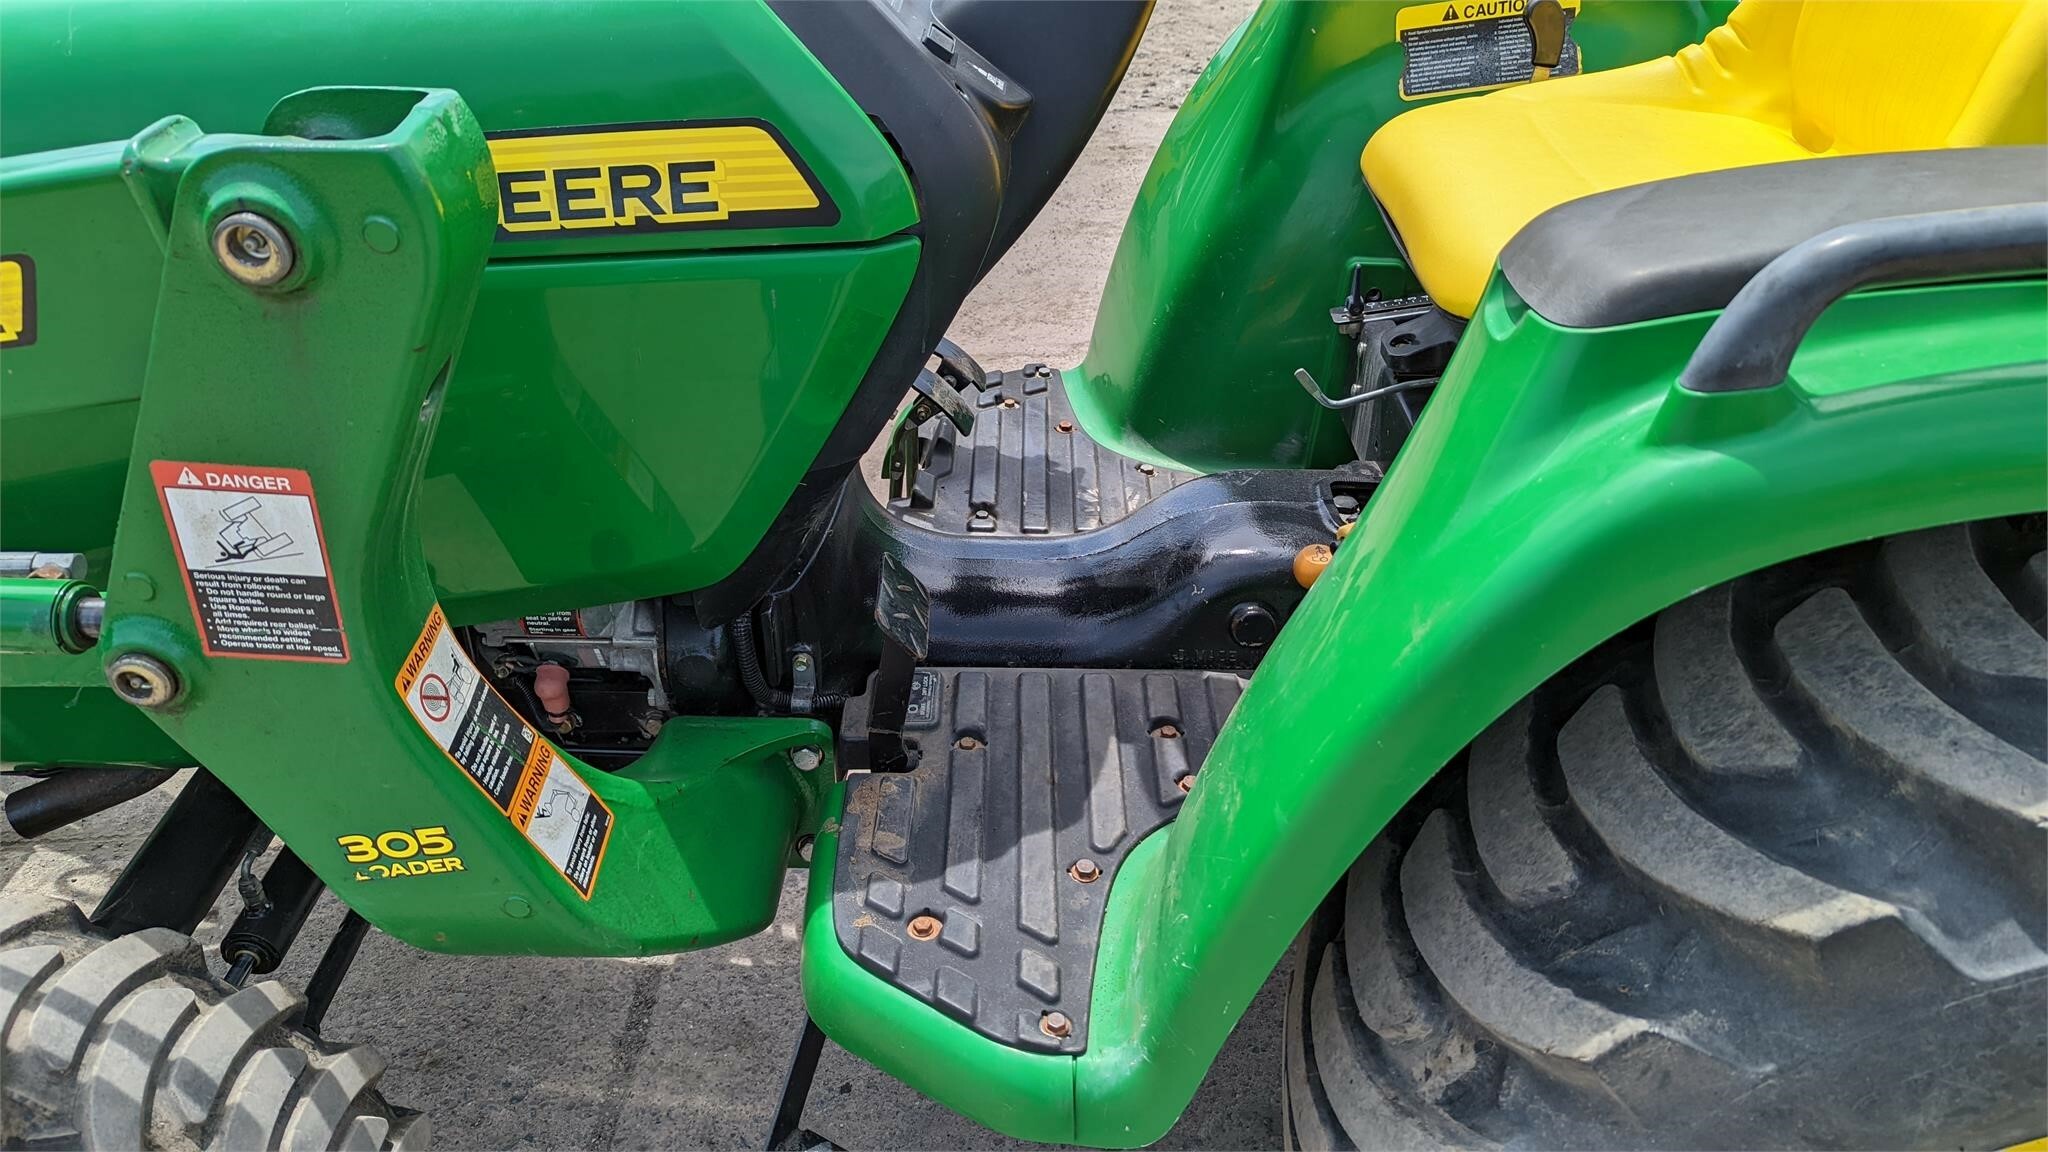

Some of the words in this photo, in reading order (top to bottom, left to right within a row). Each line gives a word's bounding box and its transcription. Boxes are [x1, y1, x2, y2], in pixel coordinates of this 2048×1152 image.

[1463, 0, 1526, 18] CAUTIO
[497, 160, 721, 225] EERE
[206, 472, 292, 491] DANGER
[193, 572, 226, 580] Serious
[227, 574, 251, 583] injury
[243, 582, 282, 591] rollovers.
[236, 590, 265, 598] handle
[304, 592, 326, 602] large
[238, 597, 265, 605] bales.
[228, 603, 251, 612] Rops
[288, 622, 319, 631] ballast.
[219, 633, 279, 642] recommended
[280, 636, 311, 644] setting.
[221, 640, 254, 648] Operate
[255, 642, 284, 650] tractor
[406, 612, 442, 675] WARNING
[459, 735, 468, 752] avoid
[465, 721, 474, 737] injury
[478, 736, 489, 754] handle
[483, 765, 493, 785] Handle
[520, 745, 550, 812] WARNING
[494, 780, 503, 795] Carry
[338, 826, 454, 862] 305
